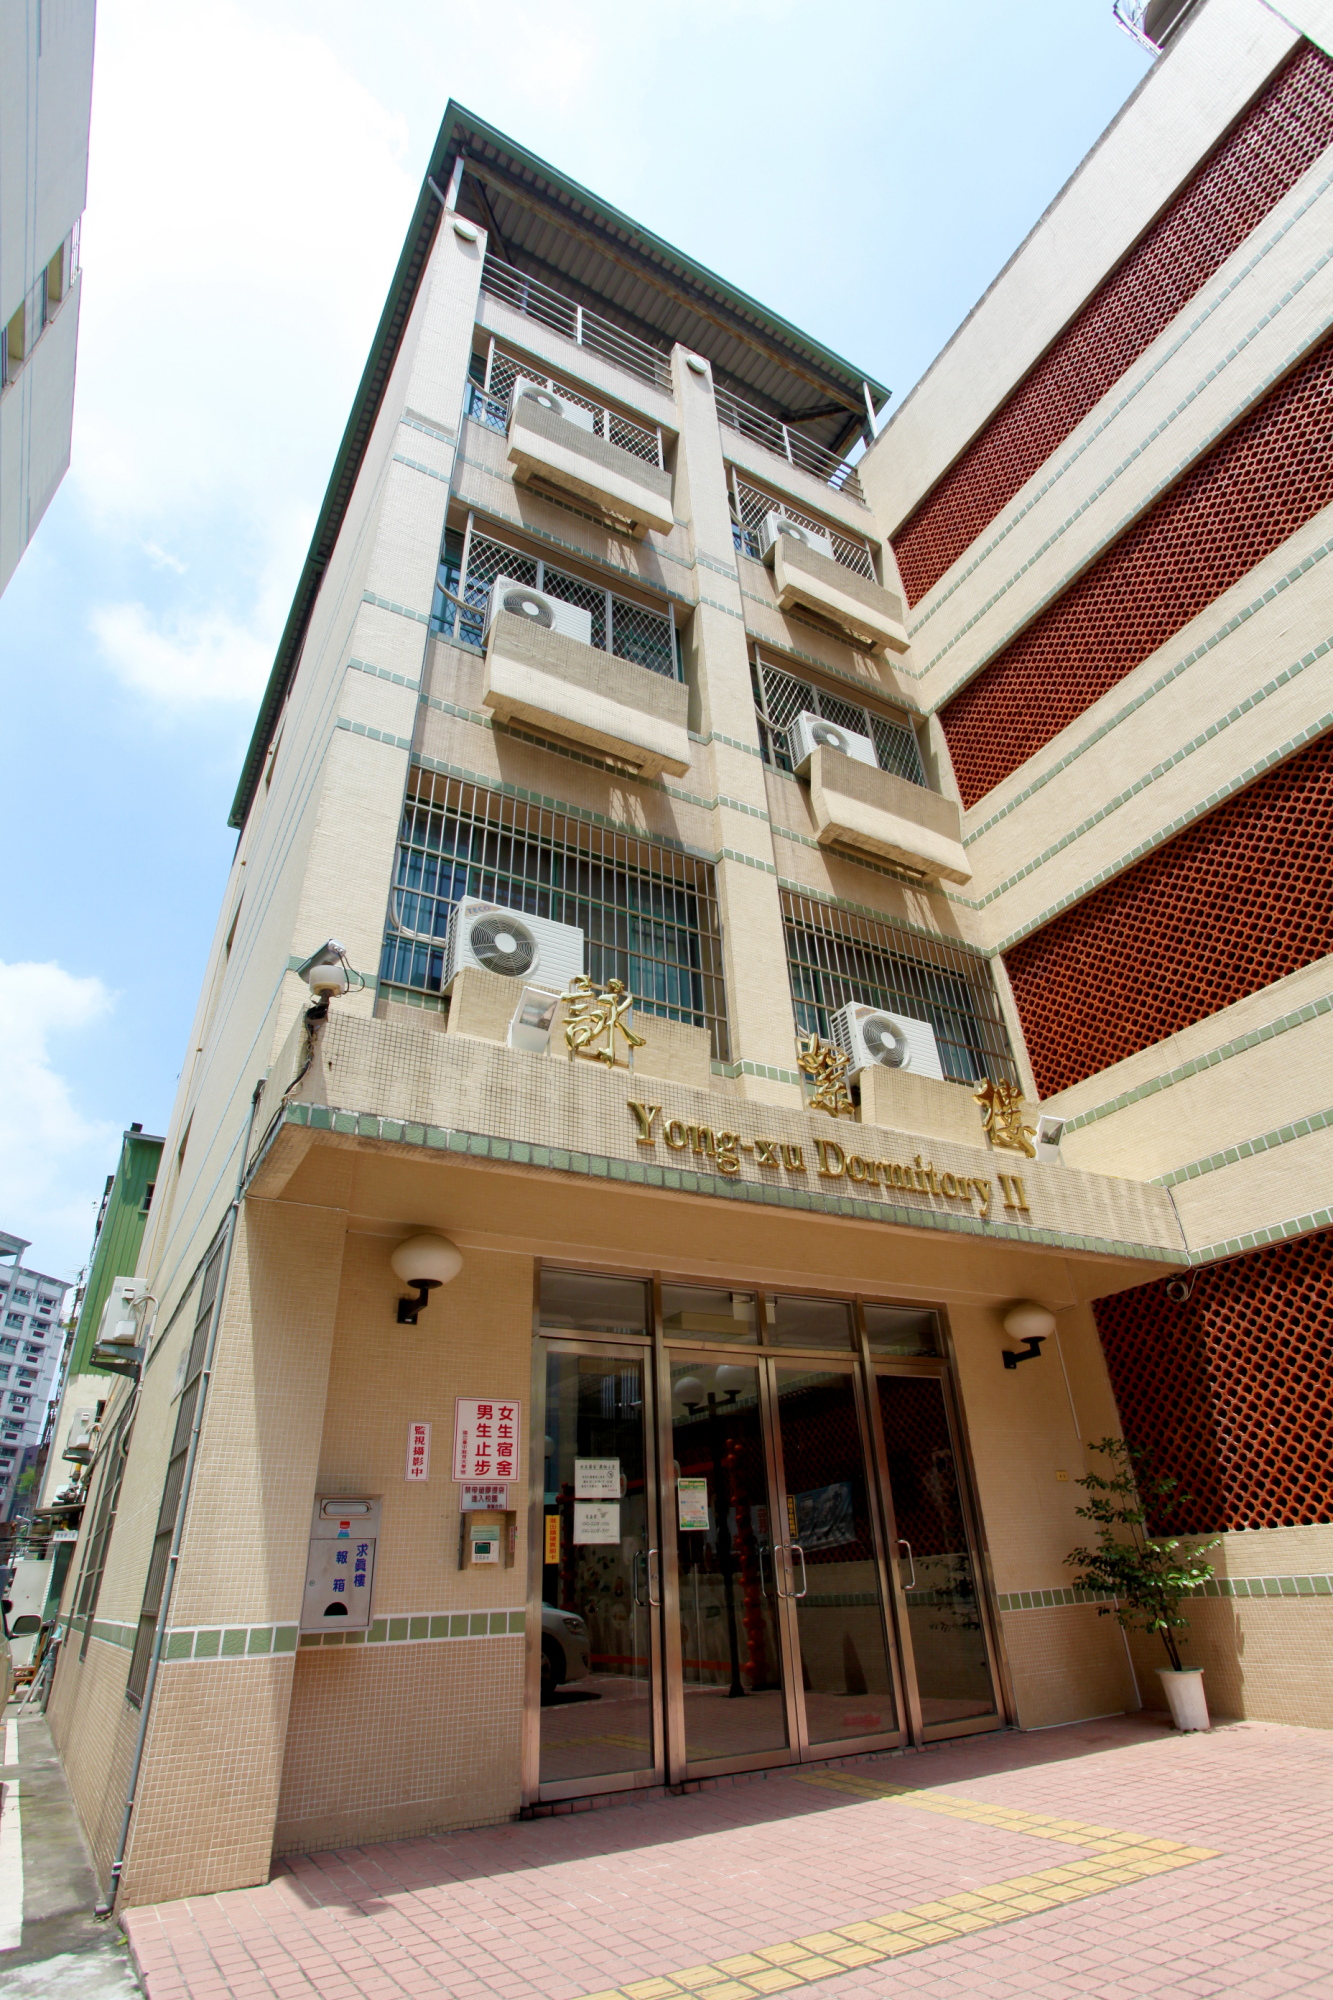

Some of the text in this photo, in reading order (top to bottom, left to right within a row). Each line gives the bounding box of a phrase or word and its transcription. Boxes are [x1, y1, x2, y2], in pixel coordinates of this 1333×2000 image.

[466, 904, 491, 915] TECO
[627, 1100, 1032, 1217] Yong-xu Dormitory II
[411, 1425, 426, 1478] 監視攝影中
[474, 1404, 493, 1476] 男生止步
[496, 1405, 514, 1476] 女生宿舍
[471, 1494, 498, 1503] 進入校園
[332, 1550, 349, 1593] 報箱
